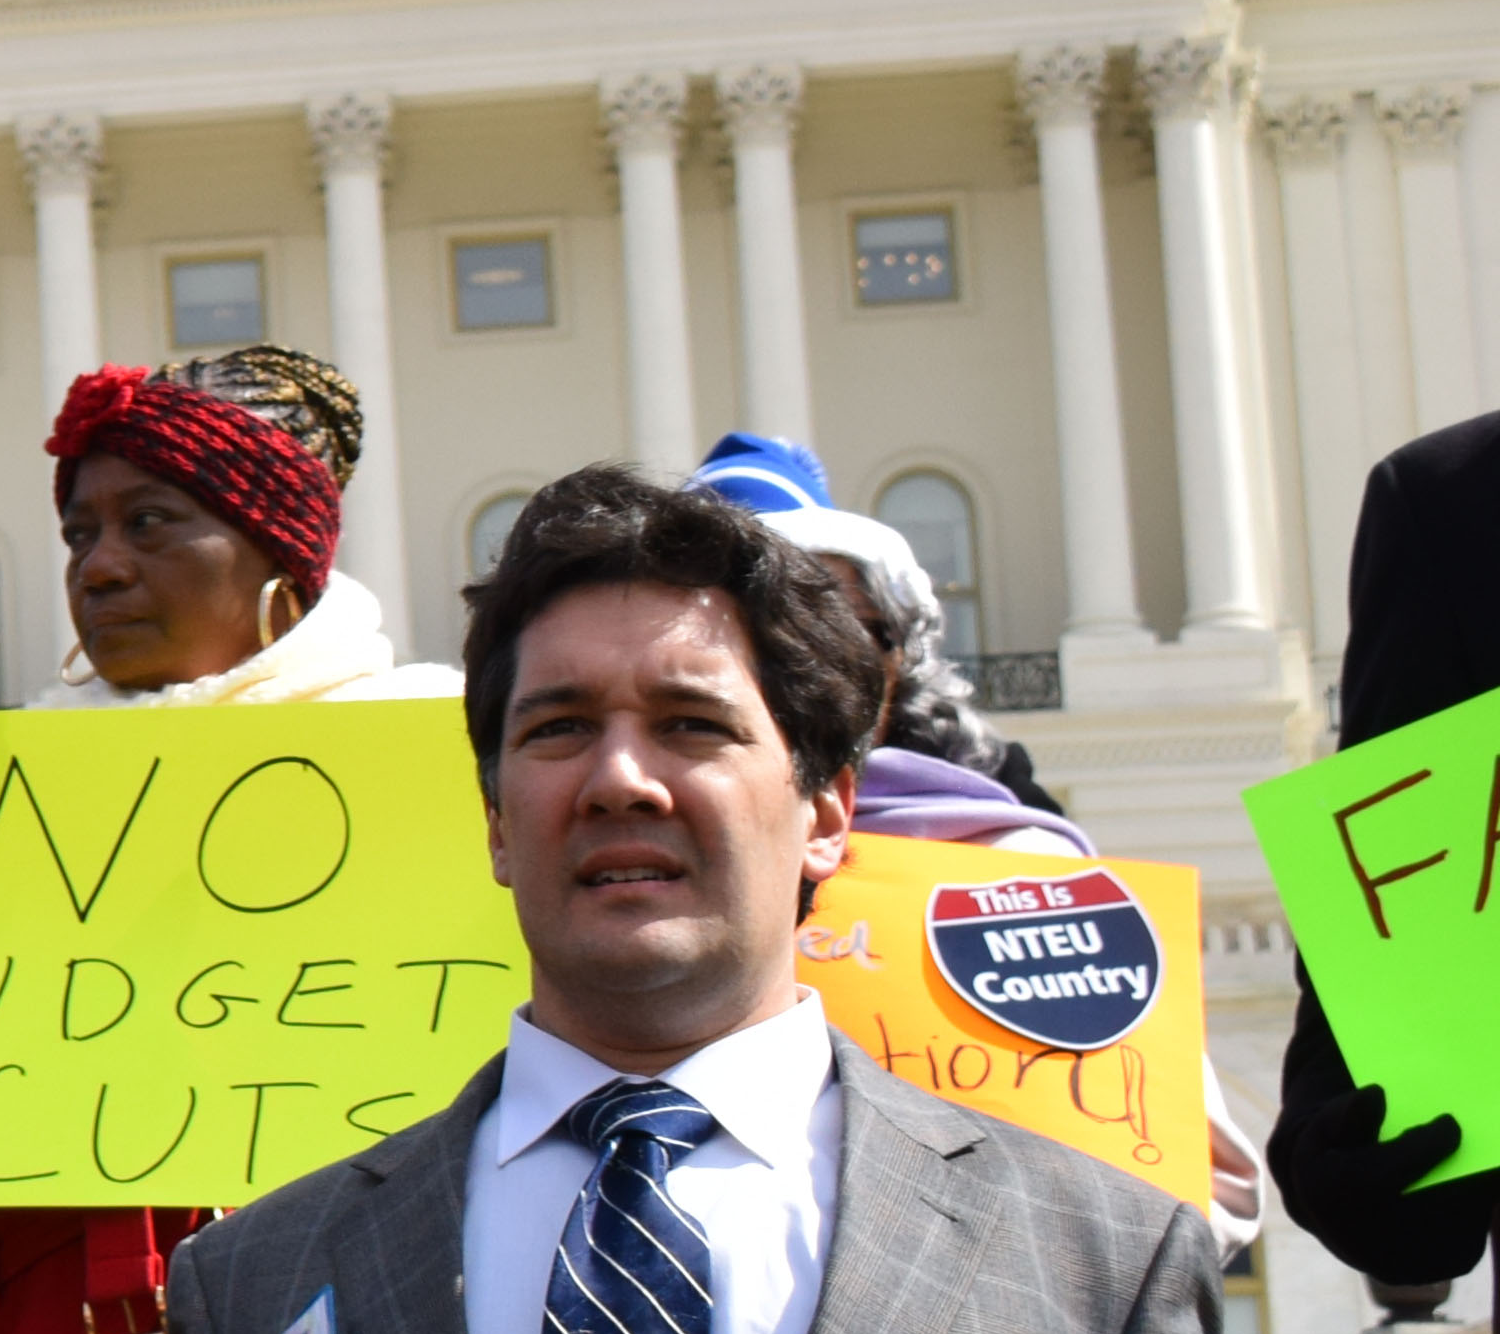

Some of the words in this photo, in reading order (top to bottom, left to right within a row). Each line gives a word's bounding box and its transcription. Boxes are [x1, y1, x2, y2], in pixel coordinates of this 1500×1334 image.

[969, 888, 1038, 915] This
[1046, 883, 1074, 908] Is
[983, 921, 1104, 963] NTEU
[972, 963, 1149, 1005] Country
